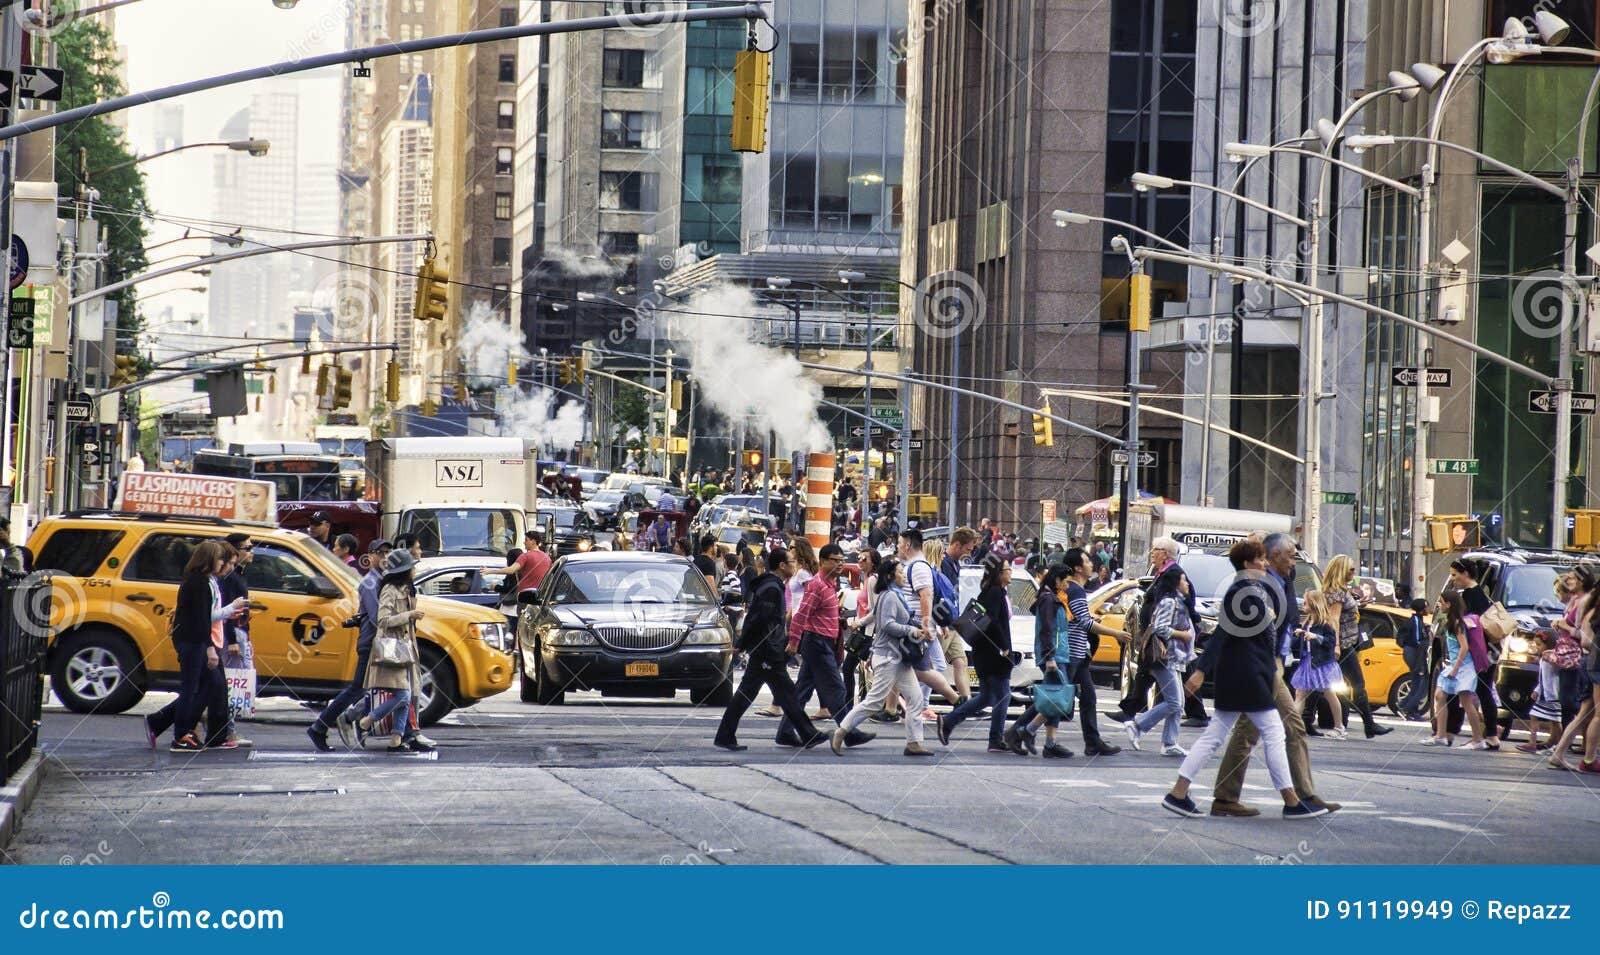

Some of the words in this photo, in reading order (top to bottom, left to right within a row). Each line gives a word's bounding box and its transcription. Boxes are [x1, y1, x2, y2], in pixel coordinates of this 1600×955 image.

[440, 465, 480, 481] NSL
[1439, 461, 1447, 472] W
[1452, 461, 1467, 473] 48
[126, 475, 236, 498] FLASHDANCERS
[125, 490, 201, 507] GENTLEMEN'S
[204, 496, 234, 510] CLUB
